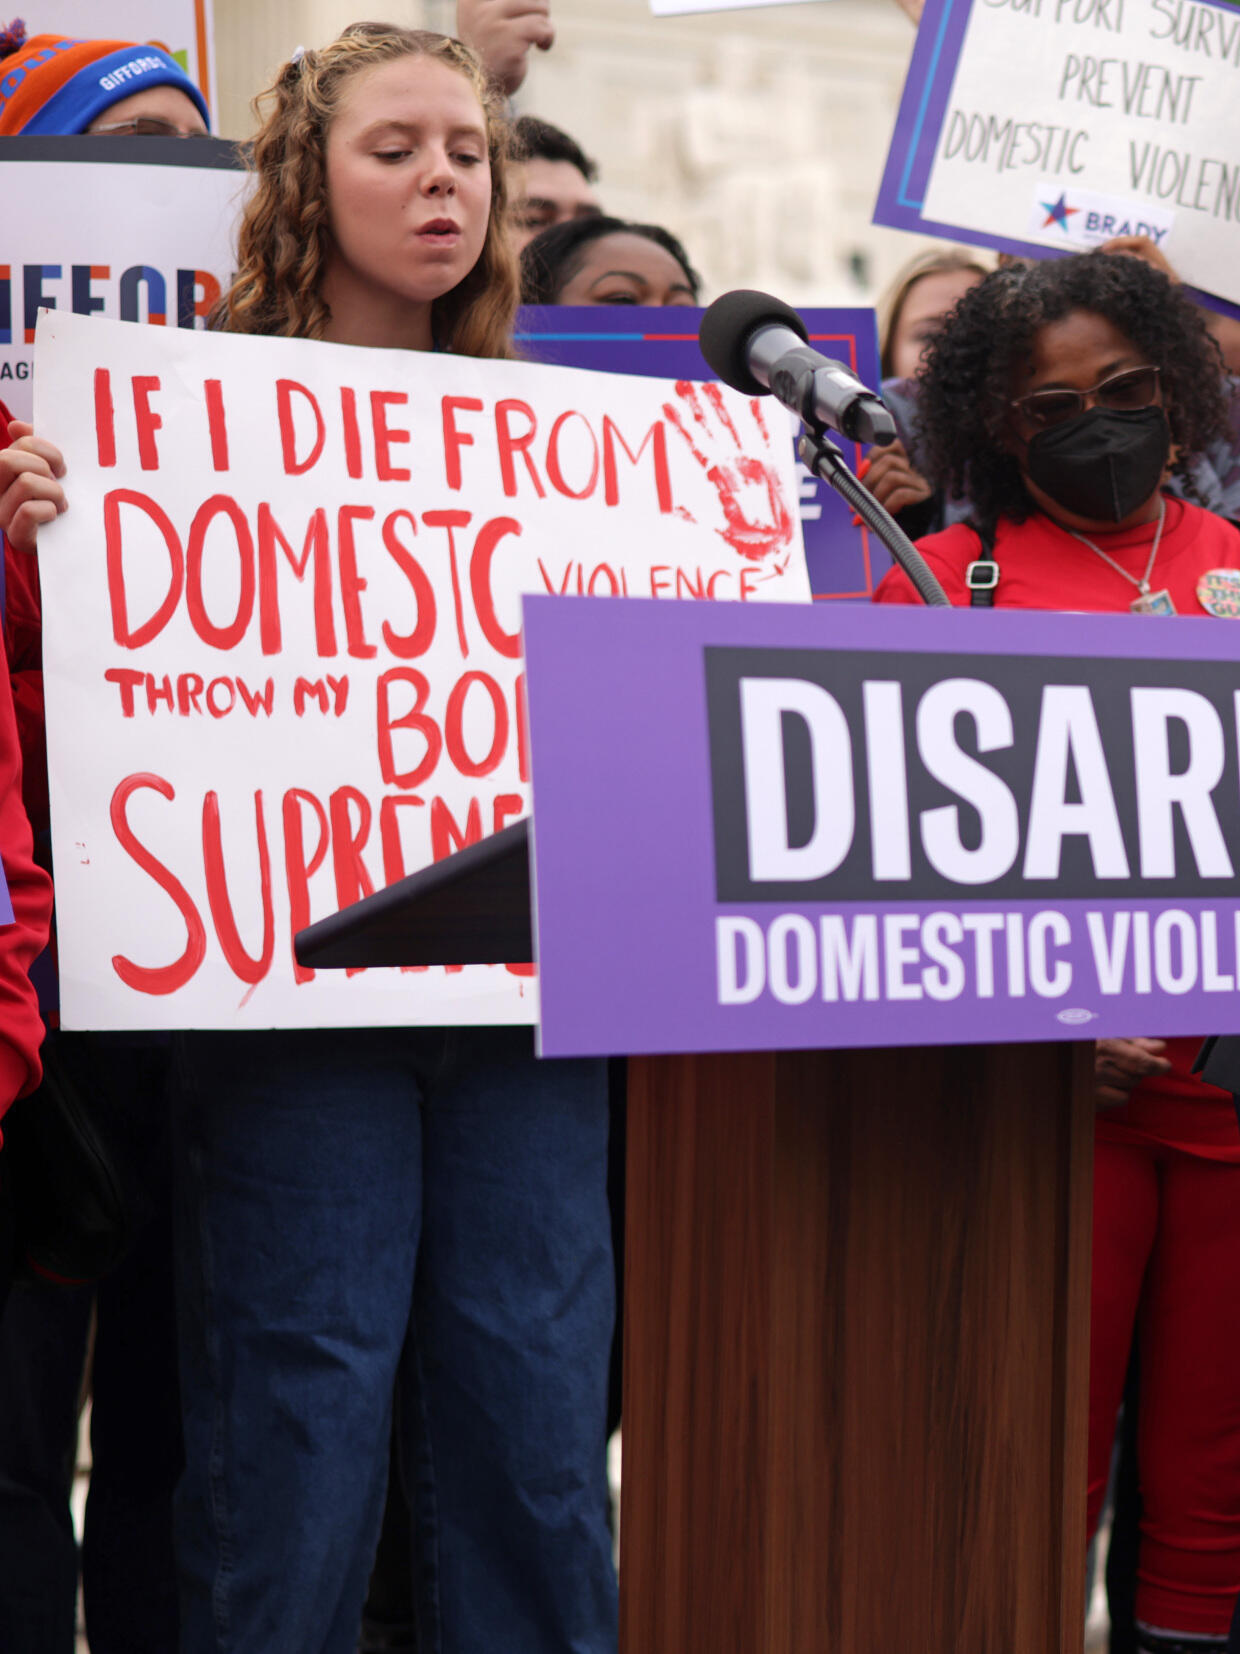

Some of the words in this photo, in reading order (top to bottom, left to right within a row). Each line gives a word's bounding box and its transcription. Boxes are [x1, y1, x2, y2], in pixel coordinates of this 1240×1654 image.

[1059, 54, 1203, 127] PREVENT
[944, 109, 1089, 176] DOMESTIC
[1085, 211, 1168, 245] BRADY
[93, 368, 162, 471] IF
[204, 379, 230, 472] I
[276, 379, 412, 481] DIE
[441, 395, 673, 514] FROM
[104, 668, 274, 718] THROW
[294, 675, 349, 718] MY
[716, 910, 1073, 1005] DOMESTIC
